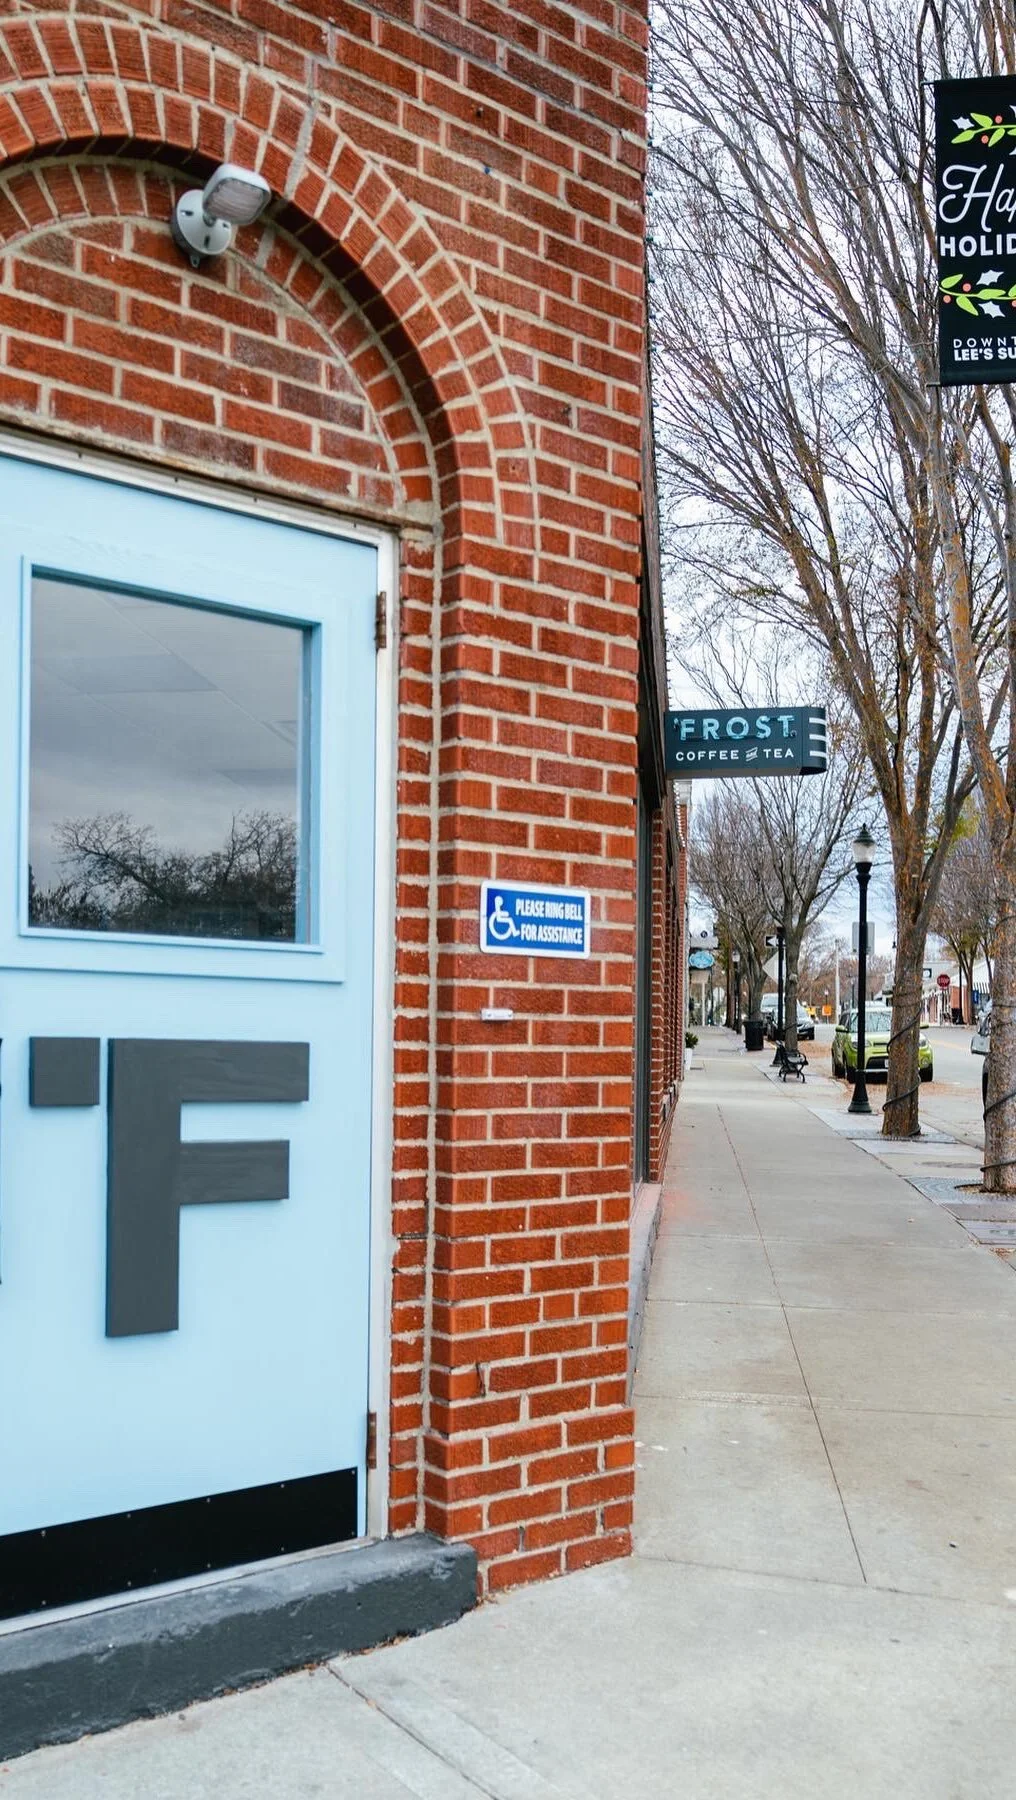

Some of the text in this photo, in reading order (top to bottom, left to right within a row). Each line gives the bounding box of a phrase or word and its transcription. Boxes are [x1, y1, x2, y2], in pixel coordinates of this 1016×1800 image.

[954, 348, 993, 361] LEE'S
[676, 750, 739, 761] COFFEE
[763, 748, 794, 758] TEA
[515, 898, 583, 920] PLEASE RING BELL
[520, 923, 583, 944] FOR ASSISTANCE
